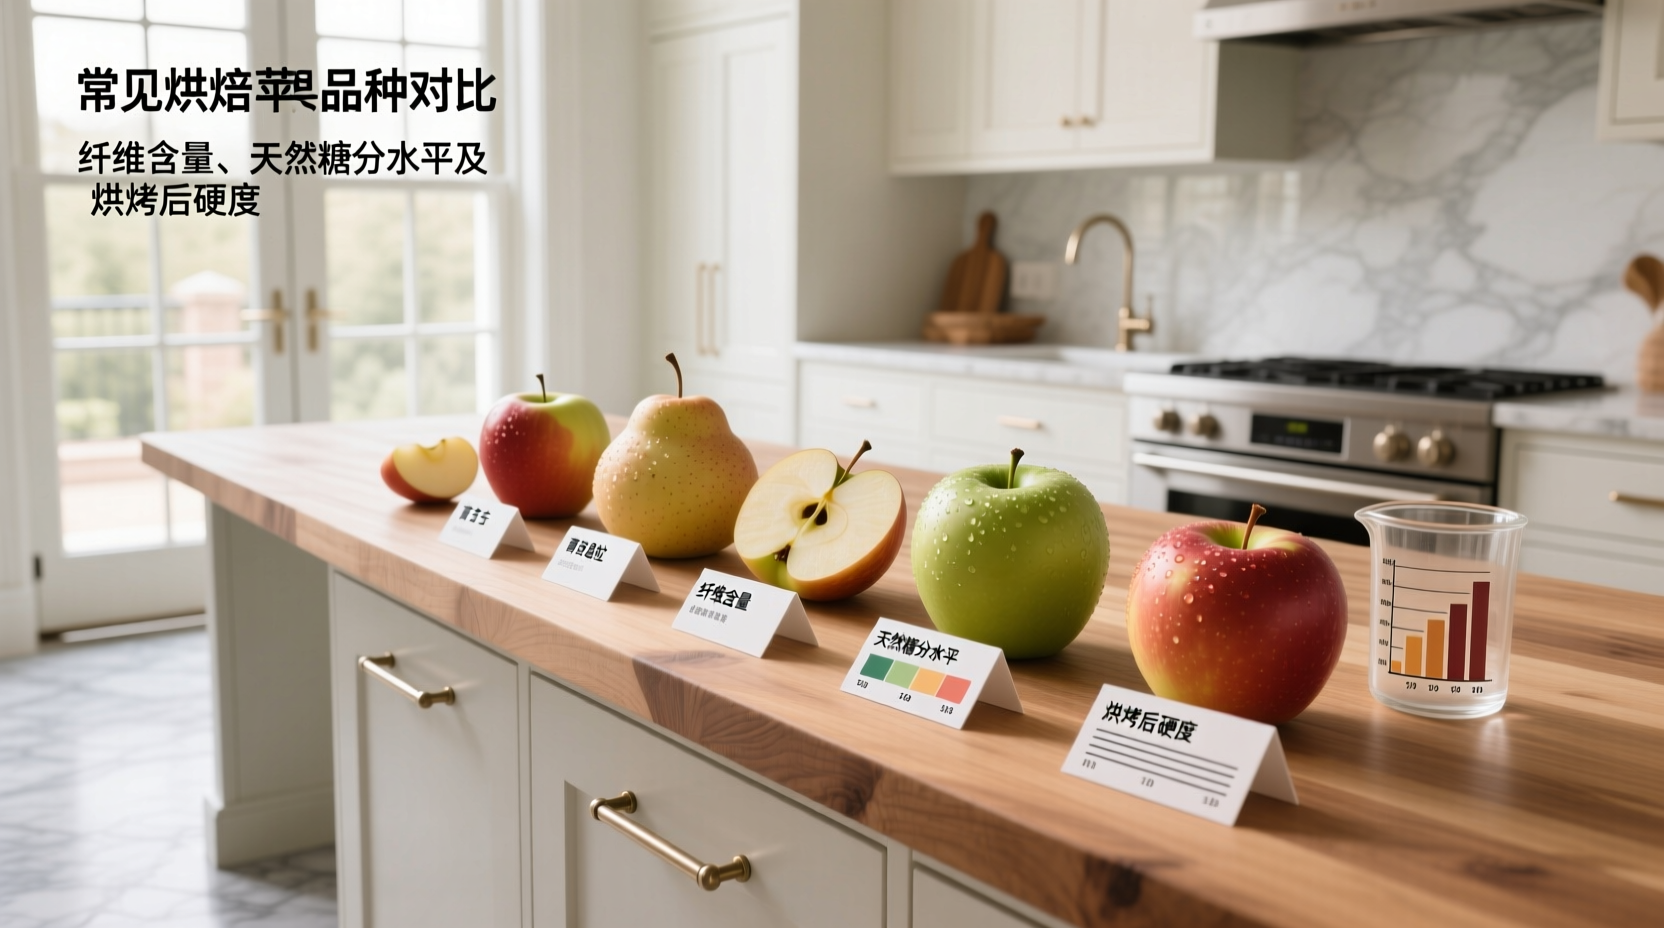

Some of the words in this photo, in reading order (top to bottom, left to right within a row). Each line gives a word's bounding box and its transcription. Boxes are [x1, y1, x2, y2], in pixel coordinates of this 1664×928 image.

[1101, 699, 1199, 744] 烘烤后硬度
